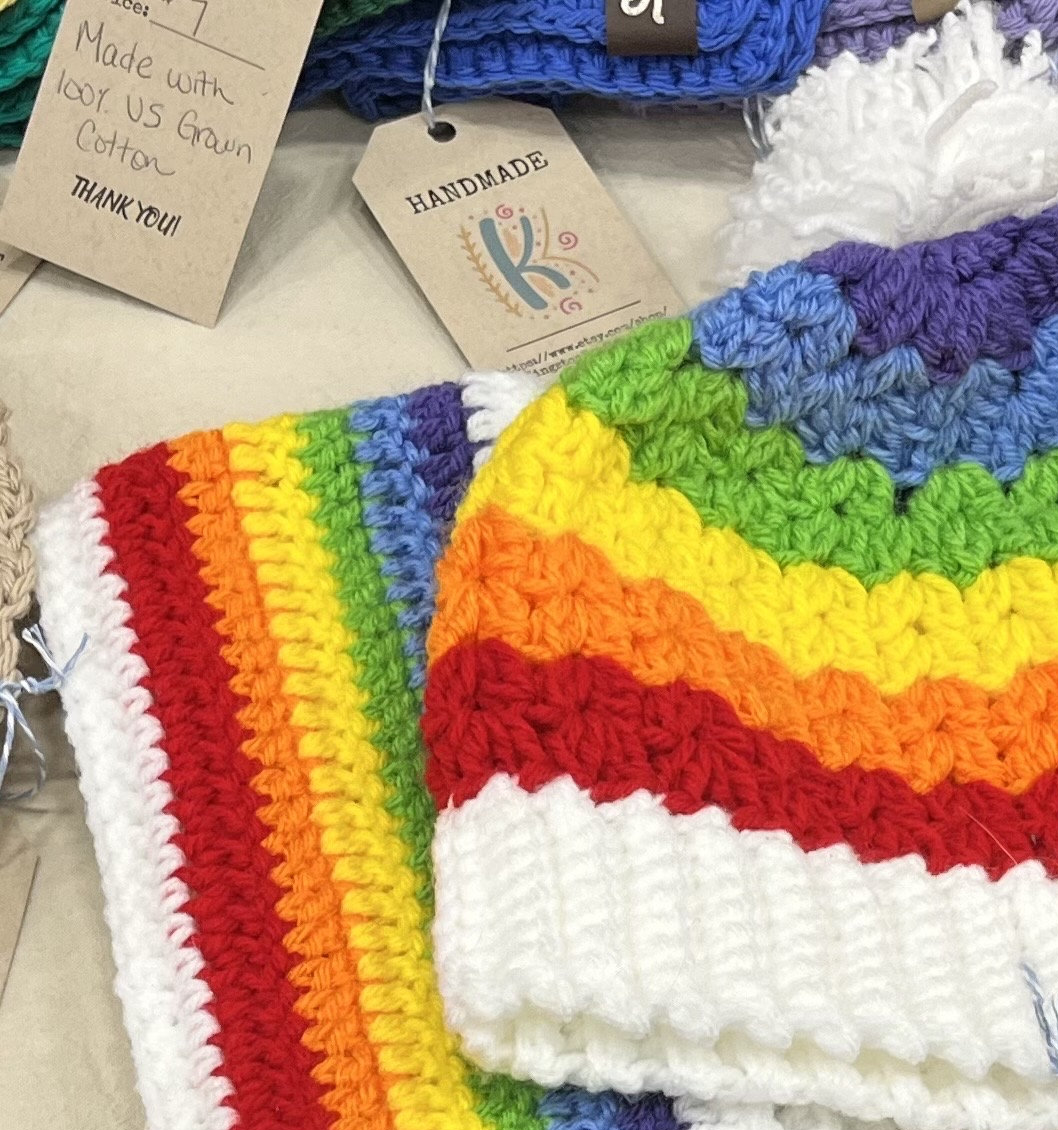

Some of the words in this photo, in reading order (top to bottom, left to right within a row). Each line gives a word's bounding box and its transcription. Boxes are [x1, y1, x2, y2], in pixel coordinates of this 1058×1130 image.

[75, 20, 152, 79] Made
[167, 66, 234, 105] with
[76, 119, 176, 176] Cotton
[127, 95, 164, 128] US
[177, 109, 251, 164] Grown
[71, 175, 134, 220] THANK
[135, 201, 182, 237] YOU!
[405, 150, 549, 215] HANDMADE
[506, 305, 667, 371] ttps://www.etsy.com/shop/
